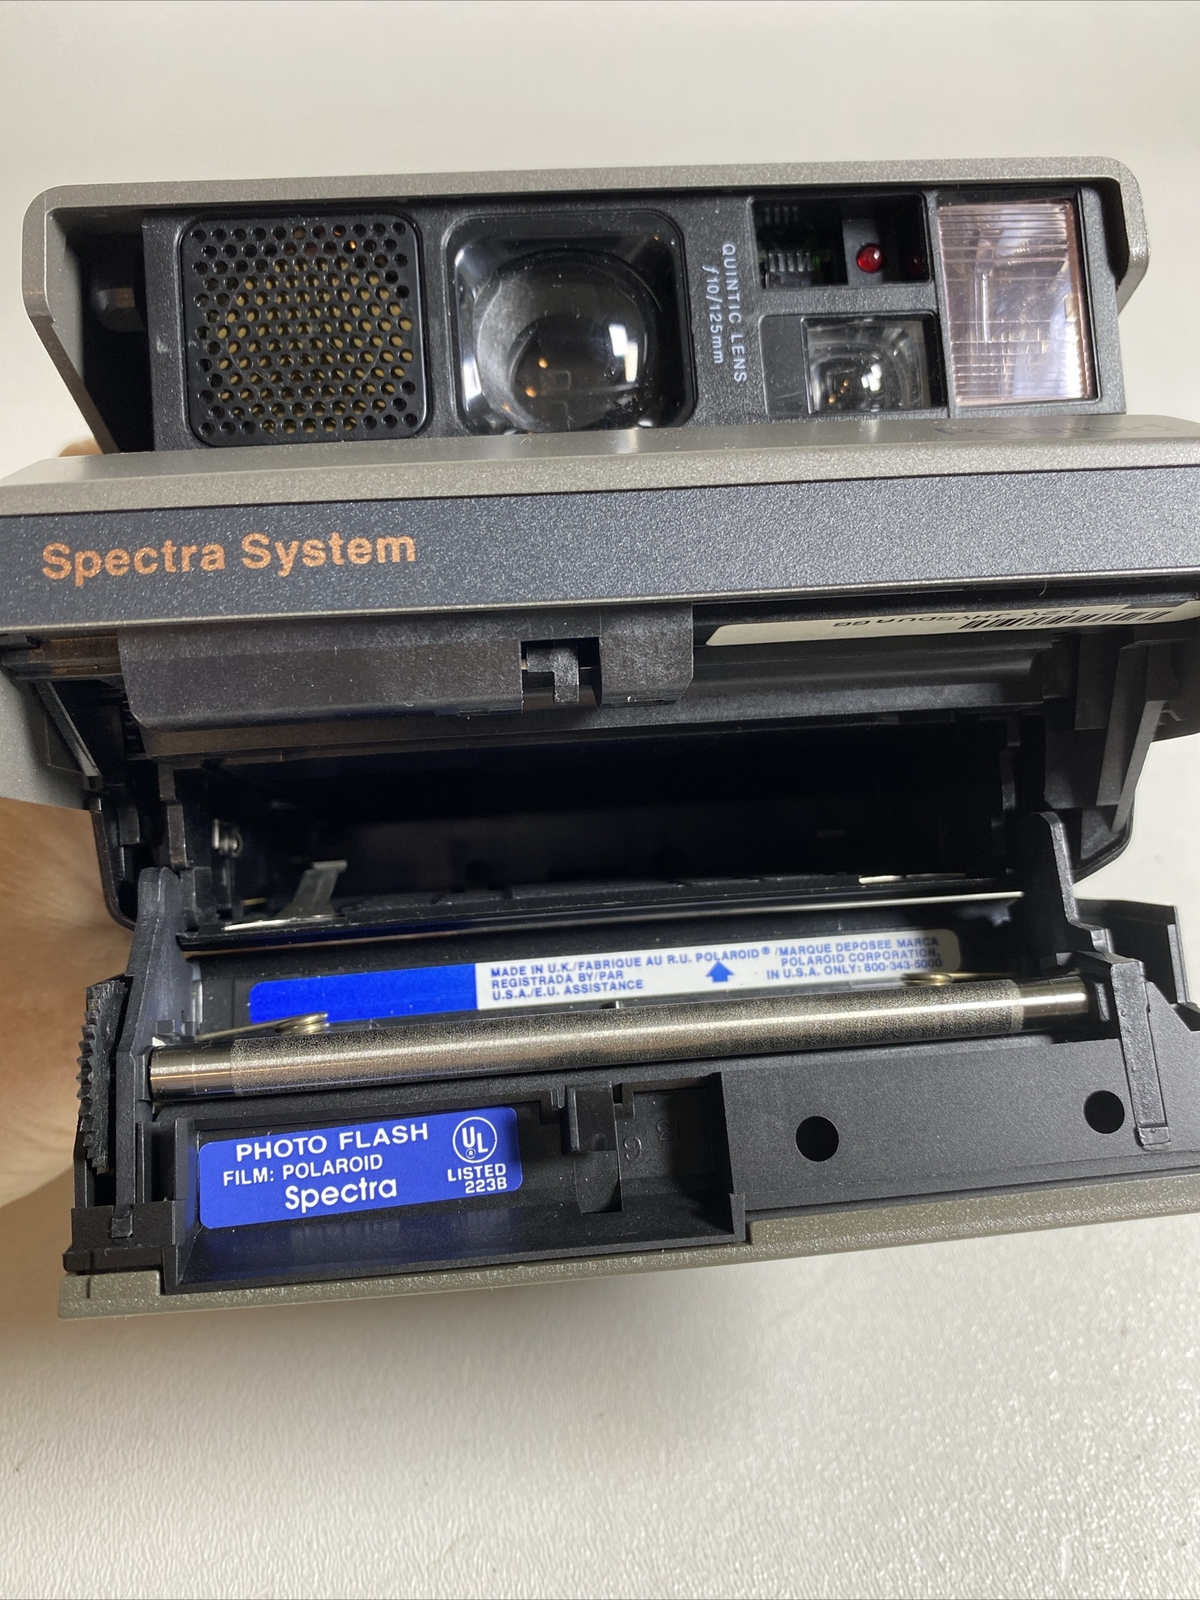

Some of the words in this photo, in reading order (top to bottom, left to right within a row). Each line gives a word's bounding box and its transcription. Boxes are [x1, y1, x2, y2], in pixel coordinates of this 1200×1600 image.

[722, 243, 742, 324] QUINTIC
[730, 333, 747, 382] LENS
[42, 539, 226, 587] Spectra
[240, 531, 416, 577] System
[491, 966, 527, 978] MADE
[531, 964, 544, 975] IN
[646, 955, 663, 966] AU
[667, 953, 692, 965] R.U.
[835, 939, 892, 952] DEPOSEE
[896, 936, 939, 948] MARCA
[491, 973, 573, 989] REGISTRADA
[578, 970, 624, 982] BY/PAR
[781, 953, 845, 967] POLAROID
[564, 979, 643, 995] ASSISTANCE
[766, 969, 780, 980] IN
[783, 965, 820, 979] U.S.A.
[824, 962, 862, 976] ONLY:
[864, 957, 943, 973] 800-343-5000
[235, 1135, 327, 1162] PHOTO
[339, 1122, 429, 1151] FLASH
[223, 1167, 274, 1187] FILM:
[282, 1153, 383, 1181] POLAROID
[447, 1163, 507, 1183] LISTED
[465, 1176, 508, 1195] 223B
[284, 1176, 397, 1214] Spectra
